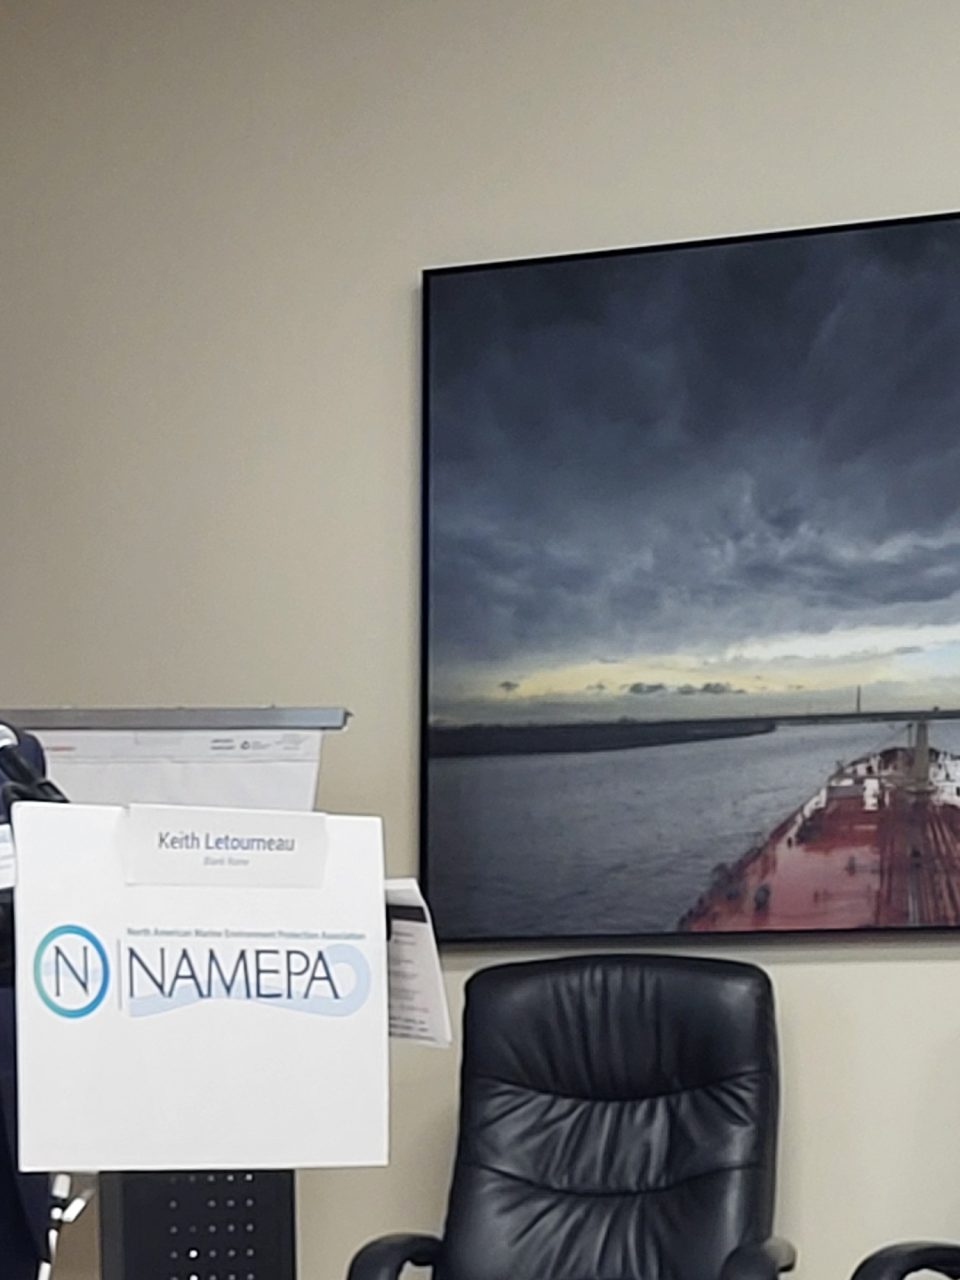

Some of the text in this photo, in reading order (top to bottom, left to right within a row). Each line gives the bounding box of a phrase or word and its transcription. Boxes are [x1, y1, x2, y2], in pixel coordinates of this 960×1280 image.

[159, 832, 200, 850] Keith
[54, 945, 89, 998] N
[128, 946, 341, 1000] NAMEPA
